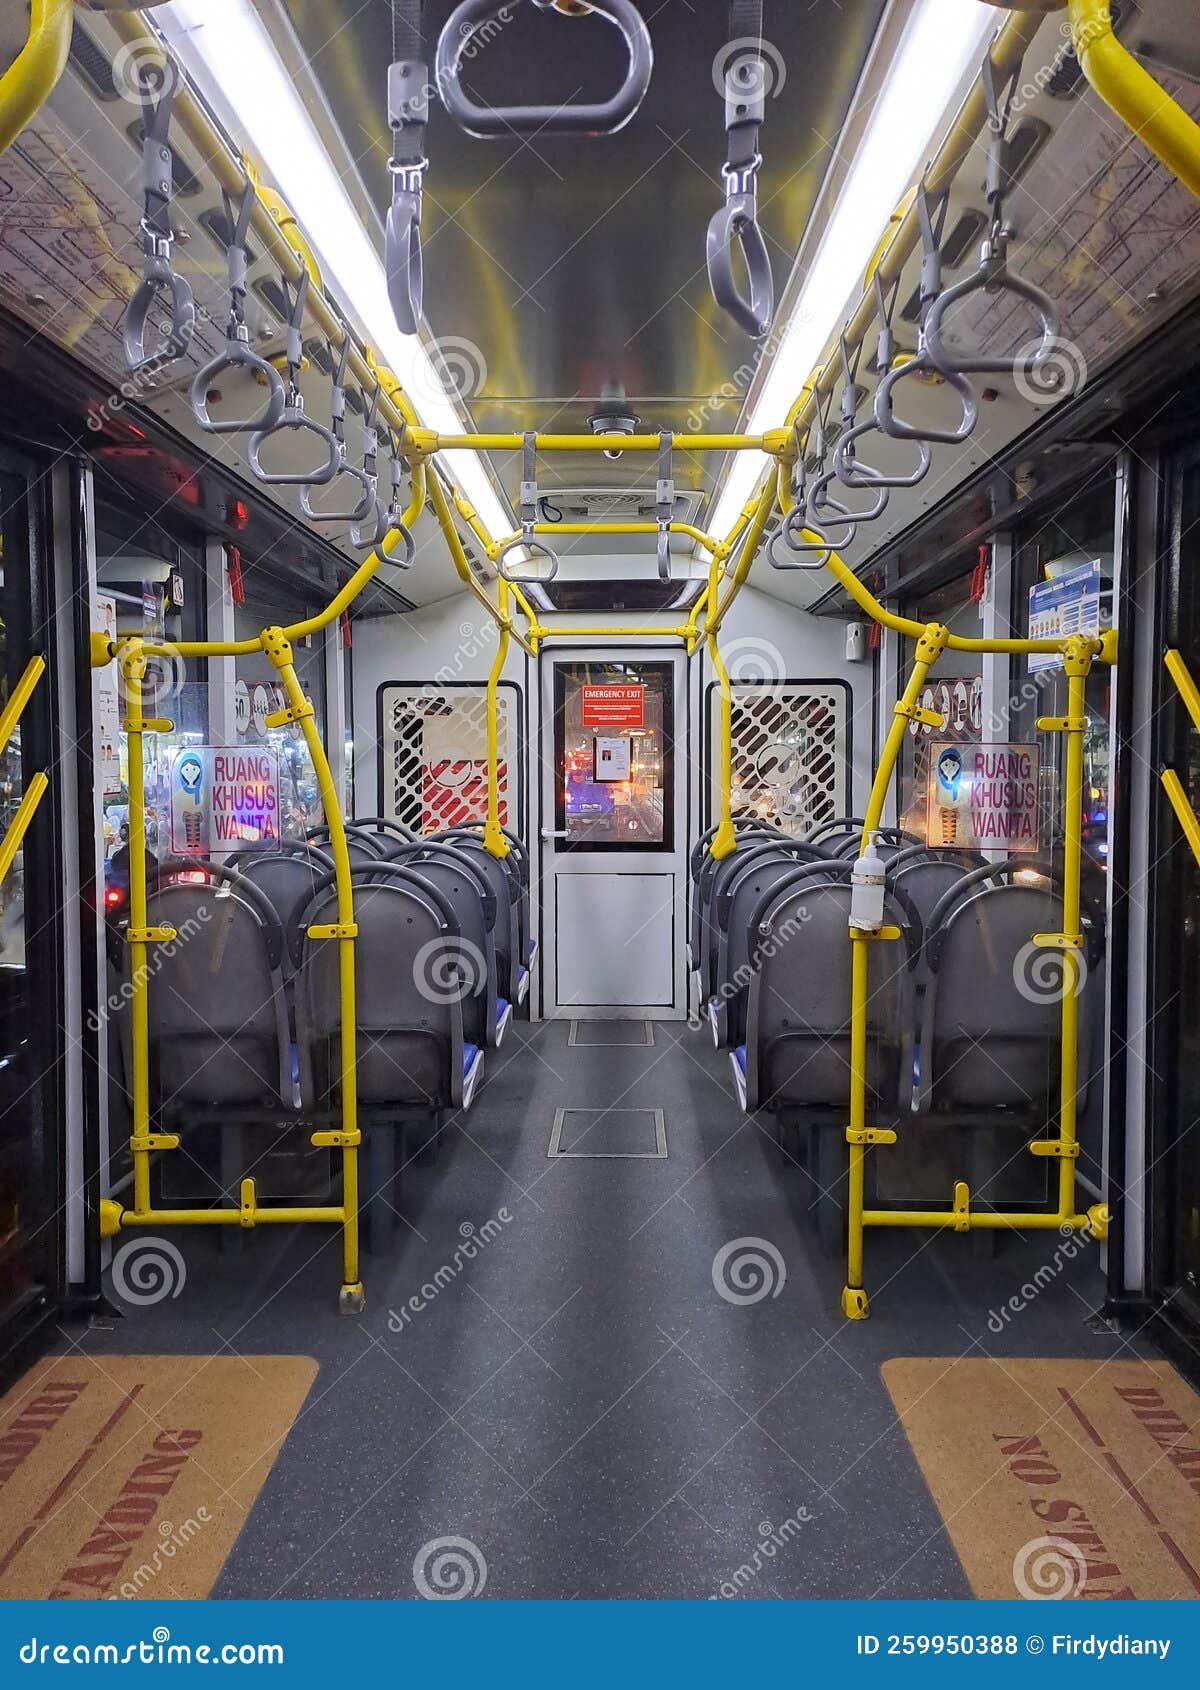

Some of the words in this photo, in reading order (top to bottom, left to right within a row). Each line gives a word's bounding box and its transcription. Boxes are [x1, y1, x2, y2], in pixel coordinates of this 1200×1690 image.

[585, 690, 626, 698] EMERGENCY
[627, 690, 640, 698] EXIT
[214, 756, 271, 782] RUANG
[974, 753, 1031, 779] RUANG
[212, 785, 276, 811] KHUSUS
[970, 783, 1035, 809] KHUSUS
[214, 815, 276, 841] WANITA
[971, 812, 1033, 838] WANITA
[992, 1434, 1062, 1485] NO
